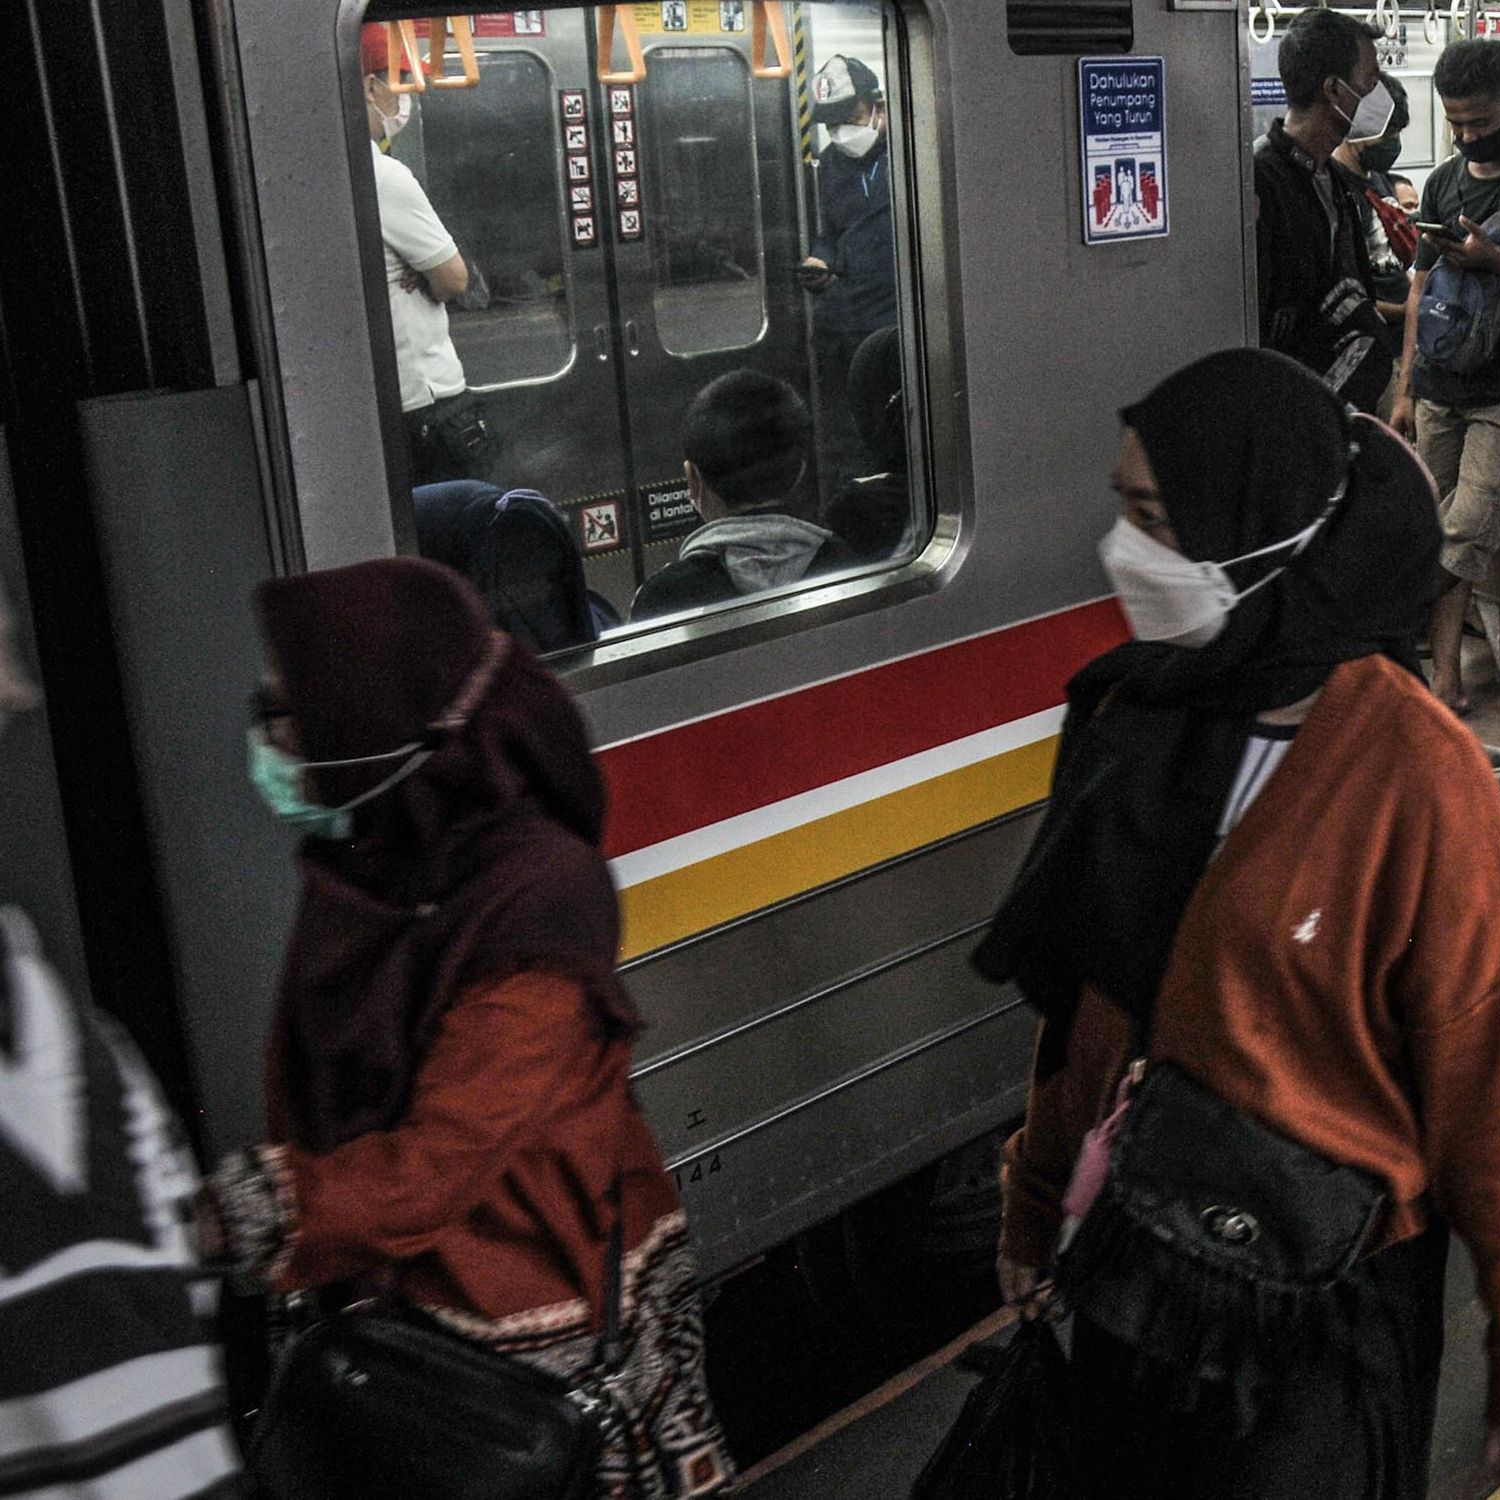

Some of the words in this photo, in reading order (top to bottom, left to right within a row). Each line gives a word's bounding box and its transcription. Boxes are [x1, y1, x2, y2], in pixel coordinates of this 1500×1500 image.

[1090, 73, 1155, 89] Dahulukan
[1090, 93, 1156, 108] Penumpang
[1094, 111, 1122, 127] Yang
[1124, 110, 1153, 124] Turun
[649, 508, 661, 521] di
